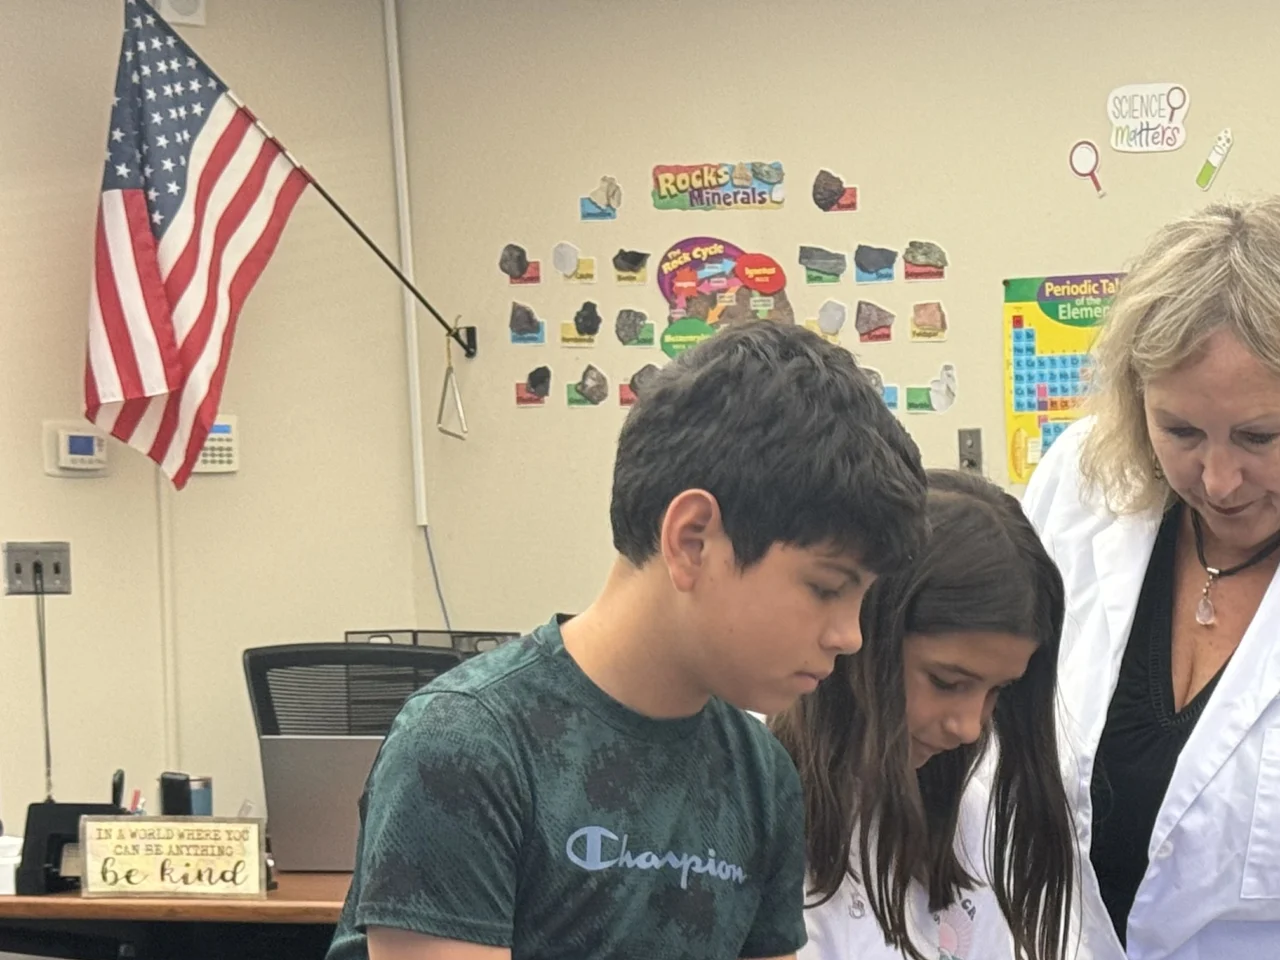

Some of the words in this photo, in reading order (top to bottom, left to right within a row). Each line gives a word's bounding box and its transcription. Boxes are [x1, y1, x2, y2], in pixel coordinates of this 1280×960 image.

[1112, 93, 1166, 119] SCIENCE
[689, 188, 767, 207] Minerals
[661, 252, 691, 274] Rock
[692, 243, 724, 261] Cycle
[1044, 279, 1100, 297] Periodic
[96, 828, 112, 840] IN
[116, 829, 125, 840] A
[130, 828, 174, 841] WORLD
[177, 829, 222, 841] WHERE
[225, 829, 250, 841] YOU
[114, 844, 140, 856] CAN
[144, 844, 164, 856] BE
[167, 844, 234, 857] ANYTHING
[101, 857, 149, 886] be
[160, 858, 248, 886] kind
